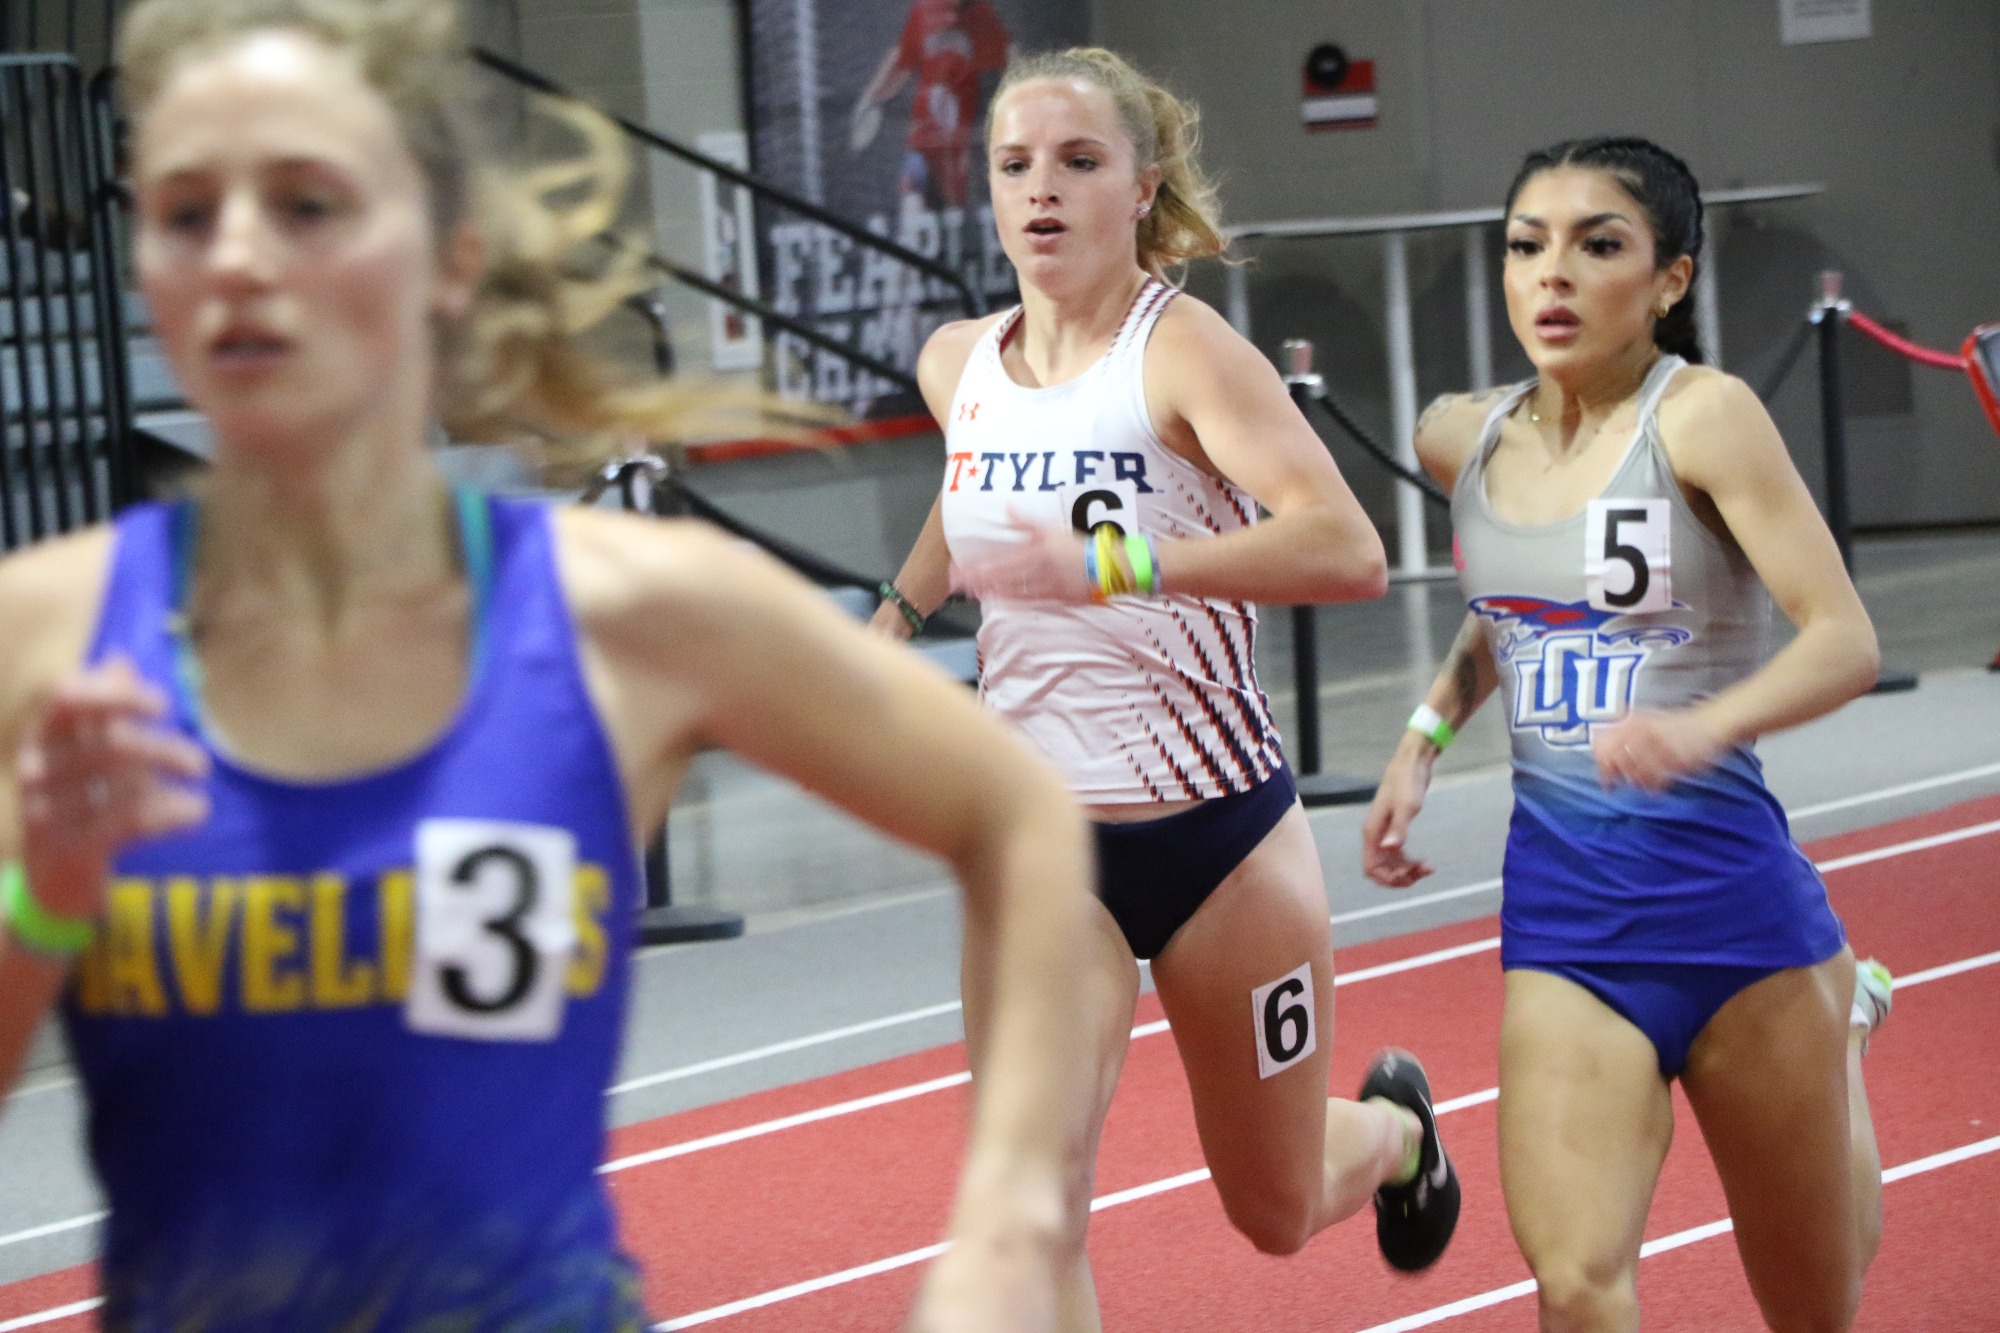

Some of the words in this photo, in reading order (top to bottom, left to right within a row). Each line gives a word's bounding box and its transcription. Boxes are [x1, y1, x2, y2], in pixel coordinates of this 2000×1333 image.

[1072, 489, 1126, 538] 6
[1603, 508, 1650, 608] 5
[1514, 634, 1646, 747] LCU
[437, 844, 541, 1015] 3
[1263, 977, 1309, 1063] 6
